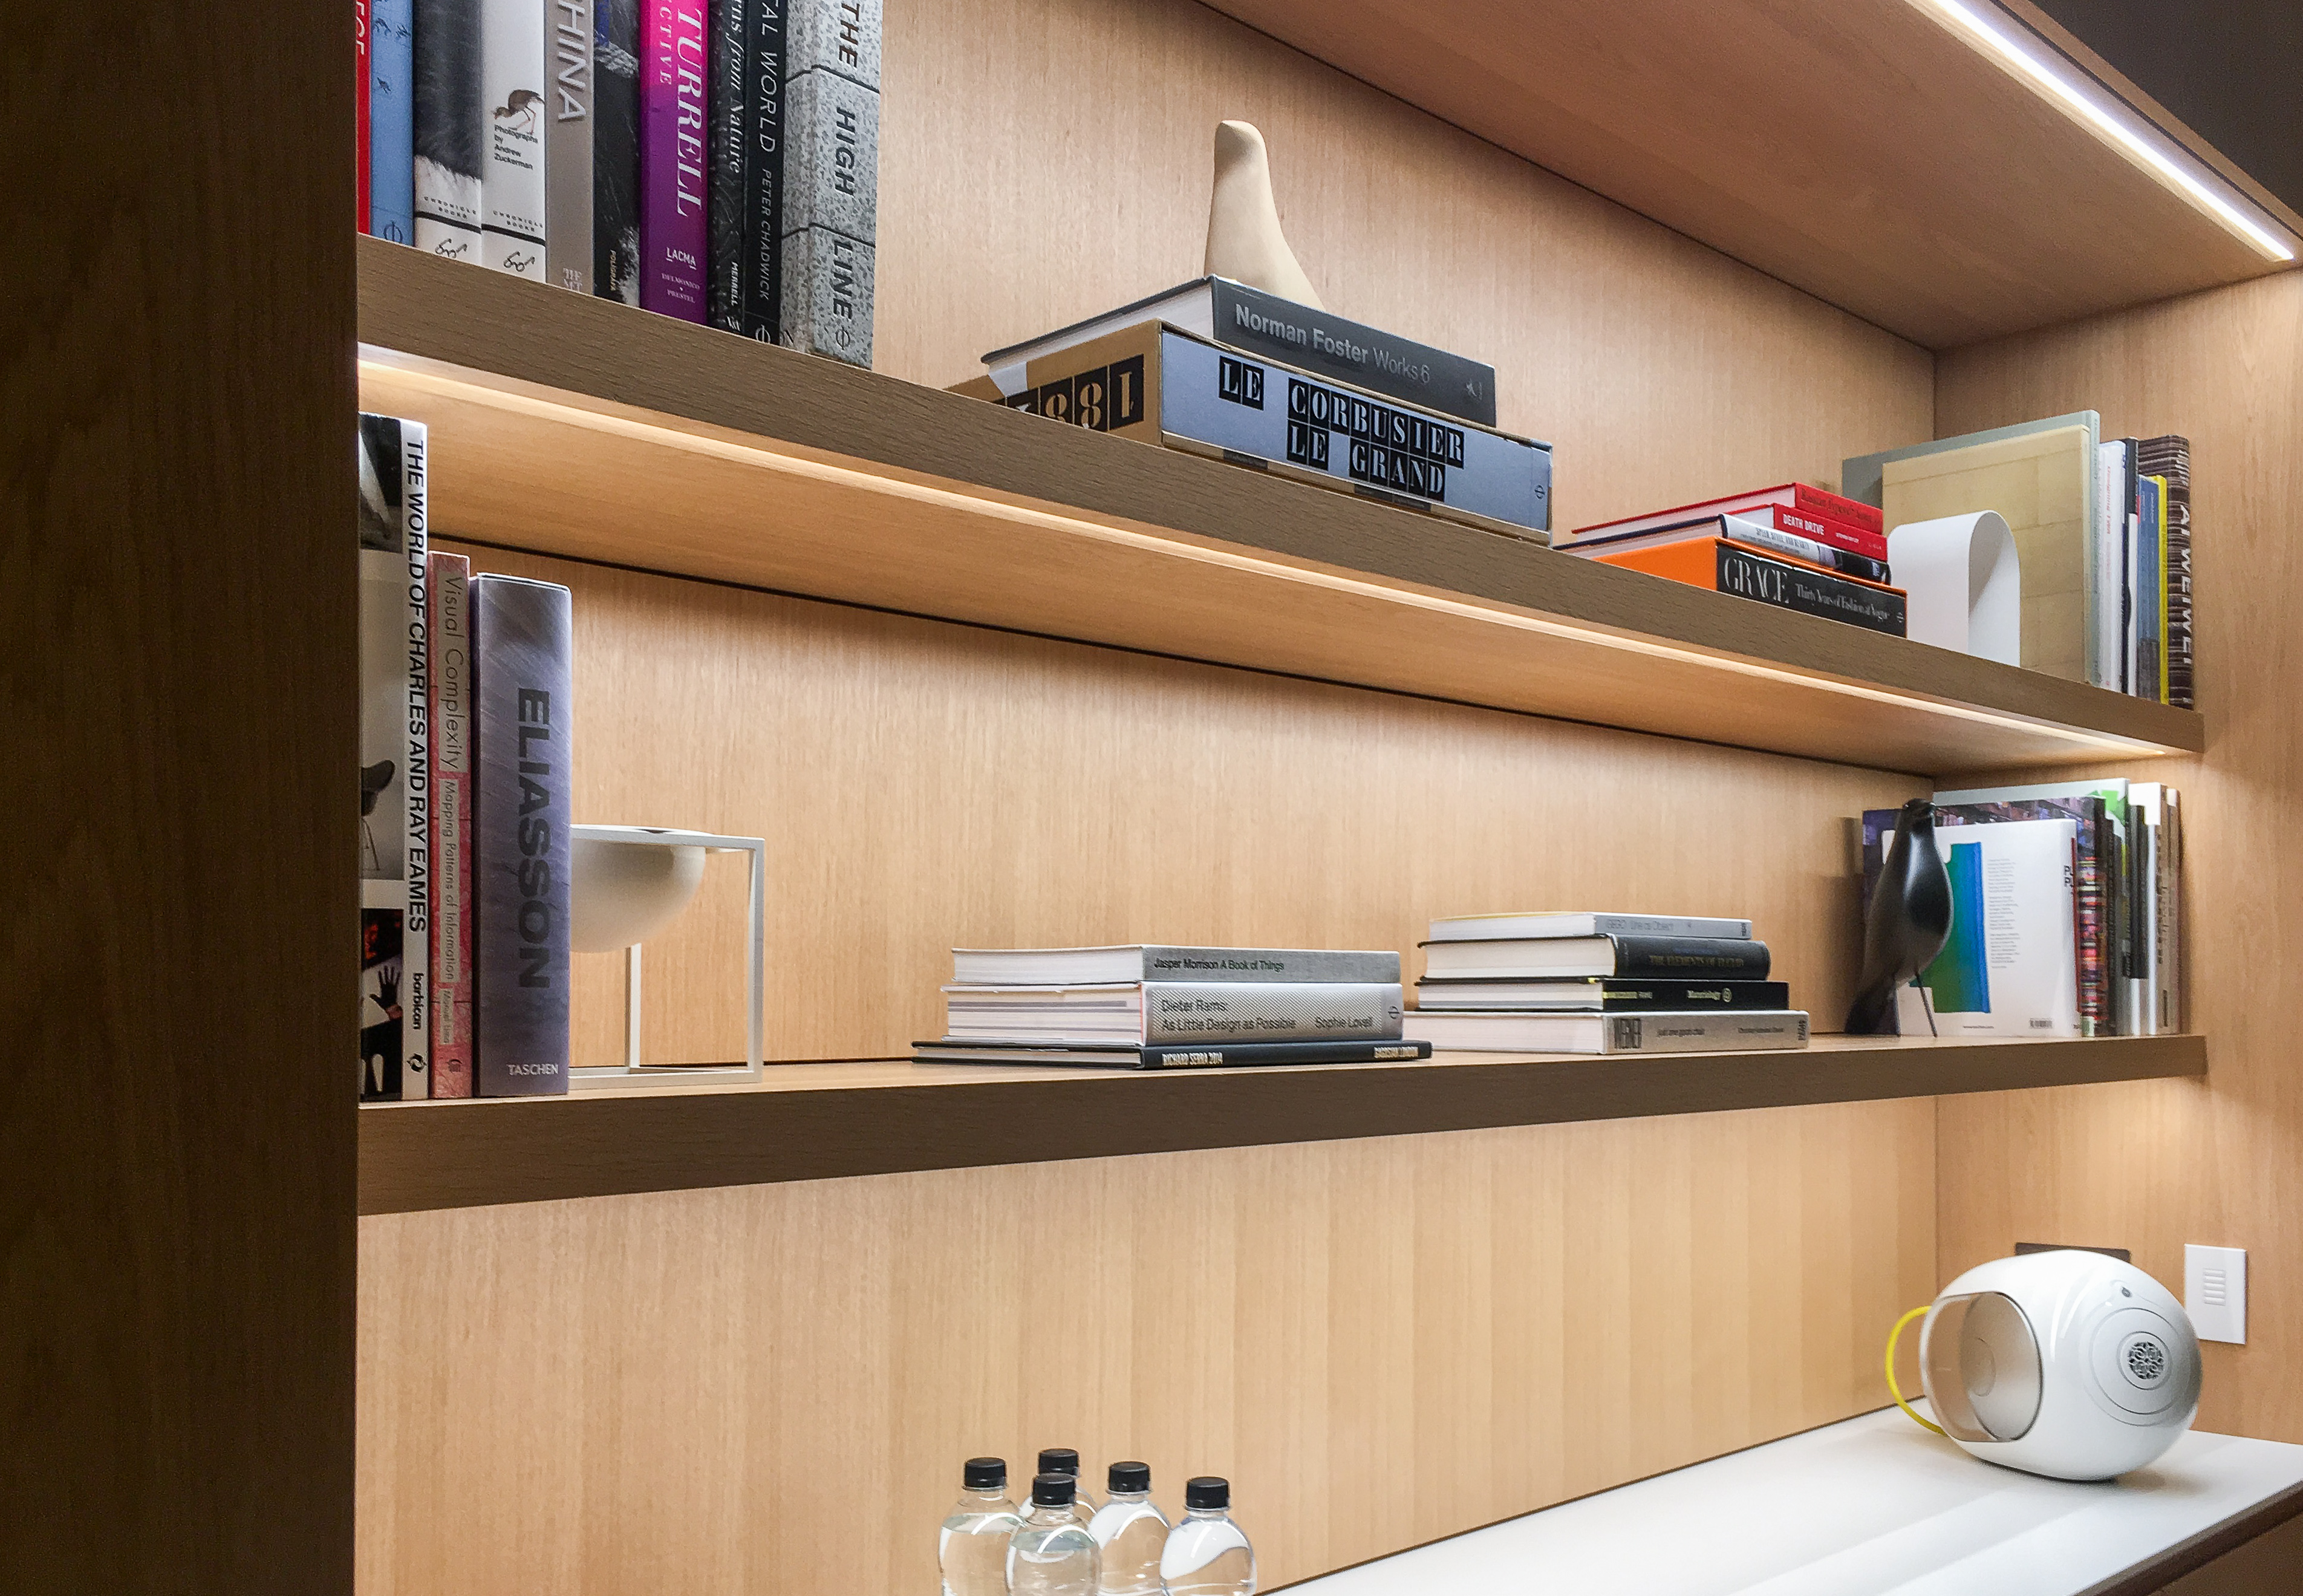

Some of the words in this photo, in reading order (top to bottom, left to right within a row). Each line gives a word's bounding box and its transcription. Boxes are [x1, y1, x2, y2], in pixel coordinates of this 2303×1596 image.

[659, 0, 672, 85] CTIVE
[761, 0, 779, 35] AL
[838, 2, 861, 70] THE
[558, 0, 587, 120] HINA
[726, 32, 744, 91] from
[677, 8, 702, 217] TURRELL
[760, 51, 778, 152] WORLD
[493, 152, 533, 171] Zuckerman
[494, 123, 539, 144] Photographs
[494, 133, 504, 145] by
[494, 143, 522, 157] Andrew
[729, 96, 744, 174] Nature
[835, 106, 856, 197] HIGH
[761, 168, 772, 216] PETER
[666, 246, 697, 270] LACMA
[731, 261, 739, 307] MERRELL
[759, 219, 772, 301] CHADWICK
[833, 239, 854, 322] LINE
[1235, 303, 1307, 346] Norman
[1312, 327, 1369, 364] Foster
[1372, 347, 1418, 380] Works
[1222, 362, 1261, 402] LE
[1291, 384, 1462, 462] CORBUSIER
[407, 440, 424, 487] THE
[1291, 425, 1326, 463] LE
[1352, 443, 1443, 494] GRAND
[408, 493, 425, 579] WORLD
[1782, 513, 1803, 530] DEATH
[1804, 520, 1825, 536] DRIVE
[2180, 504, 2191, 536] AI
[409, 584, 425, 619] OF
[445, 576, 465, 638] Visual
[1724, 557, 1790, 604] GRACE
[2181, 548, 2192, 664] WEIWEI
[409, 622, 426, 736] CHARLES
[440, 648, 466, 770] Complexity
[409, 739, 426, 792] AND
[409, 795, 426, 844] RAY
[441, 780, 456, 838] Mapping
[518, 687, 552, 989] ELIASSON
[409, 847, 426, 933] EAMES
[445, 842, 456, 890] Patterns
[445, 894, 458, 908] of
[445, 911, 458, 980] Information
[1153, 957, 1182, 971] Jasper
[1183, 958, 1219, 970] Morrison
[1220, 959, 1226, 969] A
[1228, 960, 1249, 970] Book
[1250, 960, 1259, 970] of
[1259, 960, 1285, 972] Things
[412, 972, 425, 1030] barbican
[1162, 999, 1193, 1012] Dieter
[1176, 1018, 1205, 1031] Little
[1206, 1018, 1241, 1034] Design
[1242, 1021, 1255, 1031] as
[1255, 1017, 1296, 1030] Possible
[1314, 1016, 1347, 1029] Sophie
[506, 1063, 559, 1076] TASCHEN
